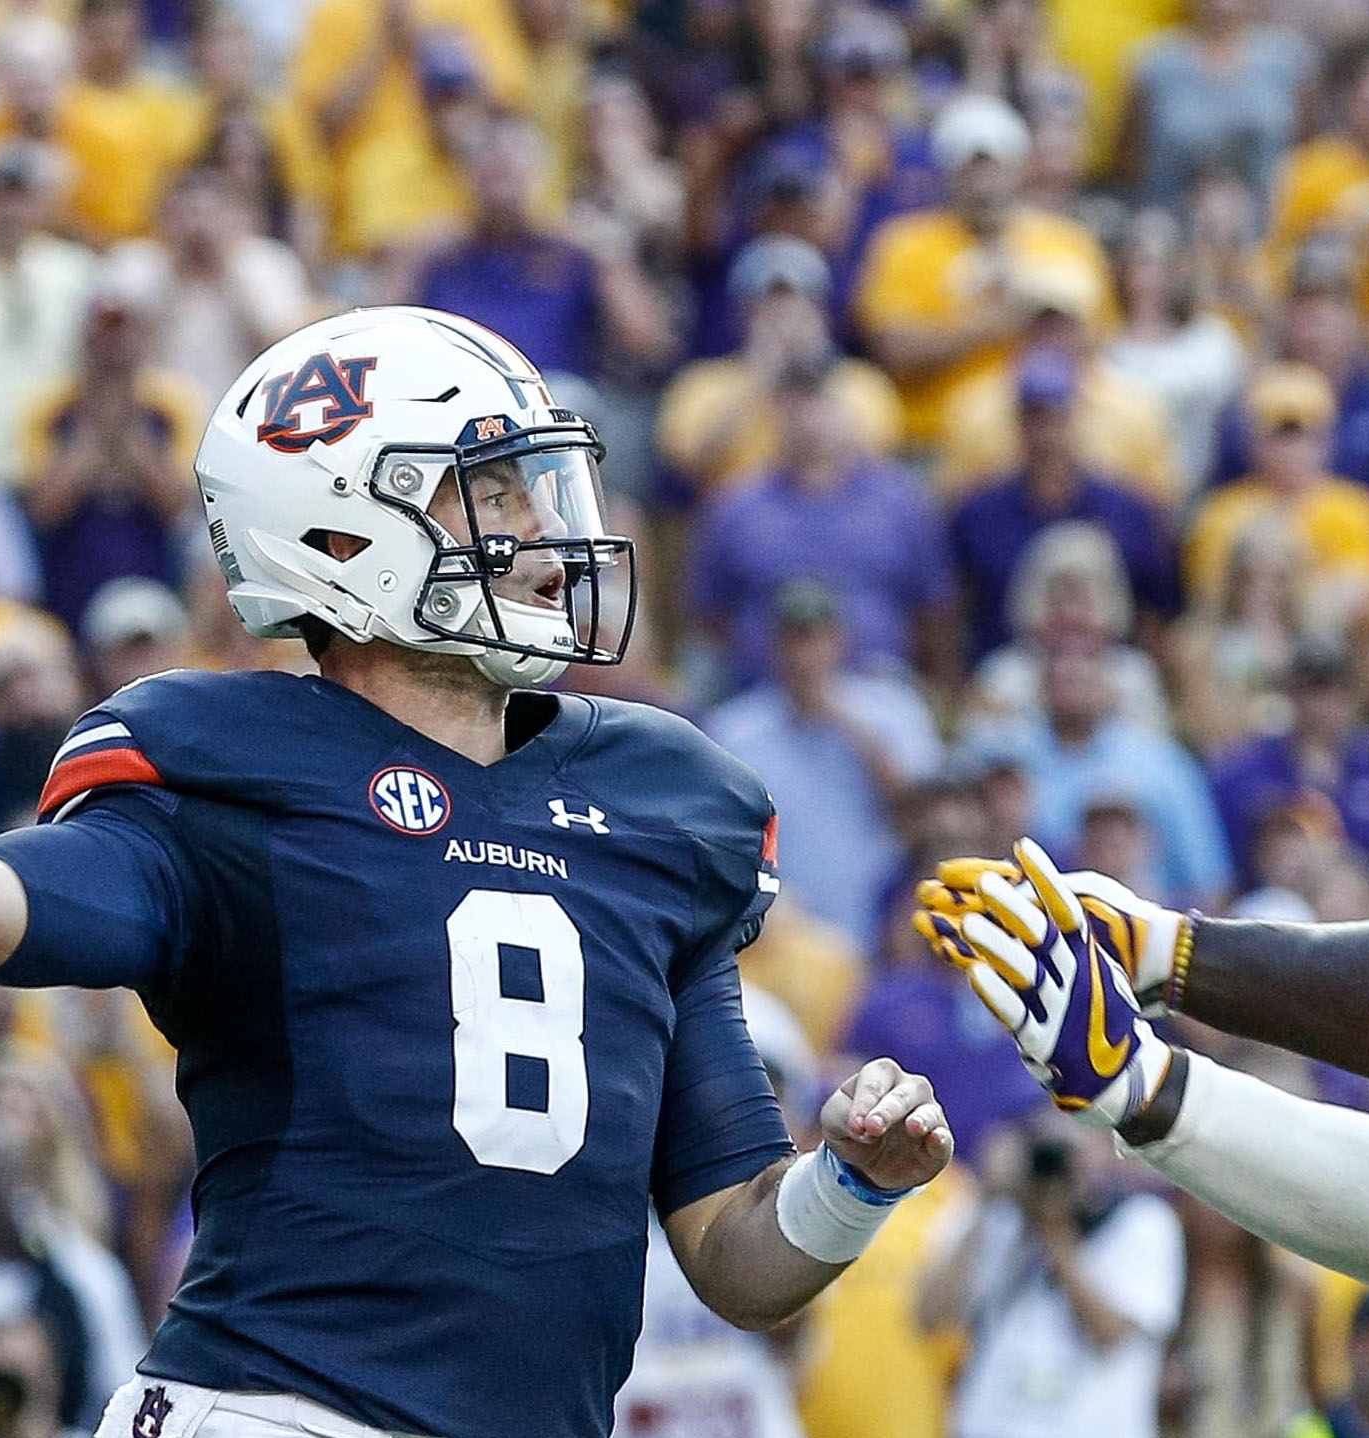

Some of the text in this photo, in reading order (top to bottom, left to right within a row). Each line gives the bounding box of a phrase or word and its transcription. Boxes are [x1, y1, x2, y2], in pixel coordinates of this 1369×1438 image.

[258, 352, 377, 453] AU
[375, 770, 445, 830] SEC
[444, 839, 569, 880] AUBURN
[446, 889, 589, 1175] 8
